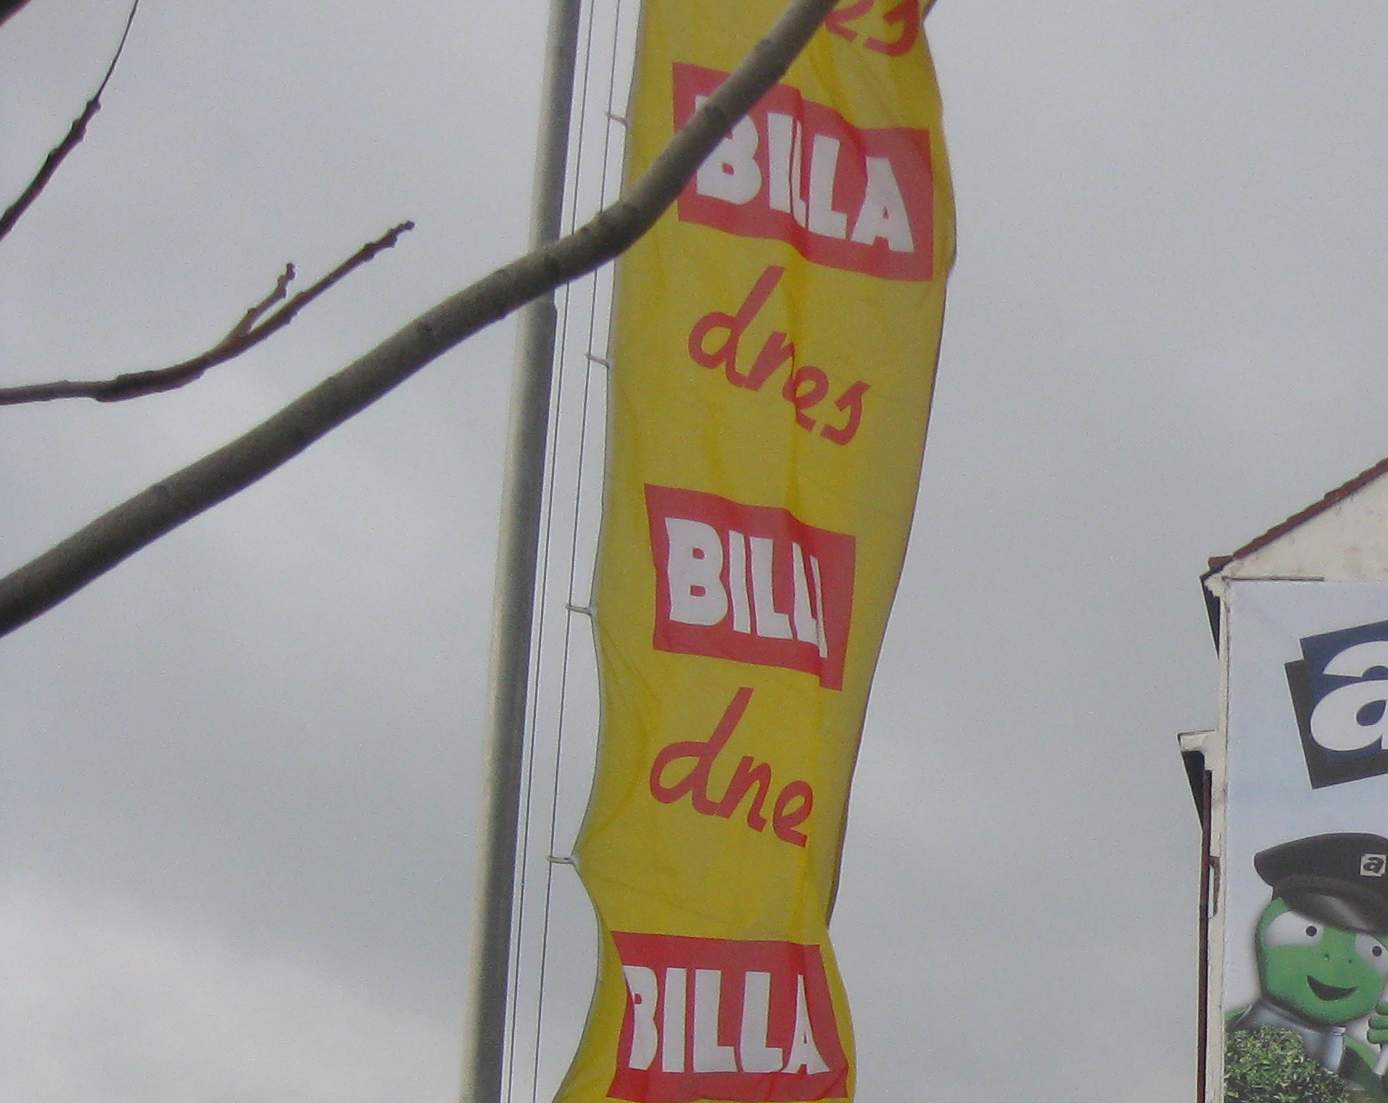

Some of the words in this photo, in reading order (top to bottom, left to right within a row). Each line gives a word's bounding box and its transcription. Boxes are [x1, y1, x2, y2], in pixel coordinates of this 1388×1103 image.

[688, 265, 871, 446] dnes
[665, 517, 828, 658] BILL
[649, 687, 814, 848] dne
[622, 965, 831, 1075] BILLA
